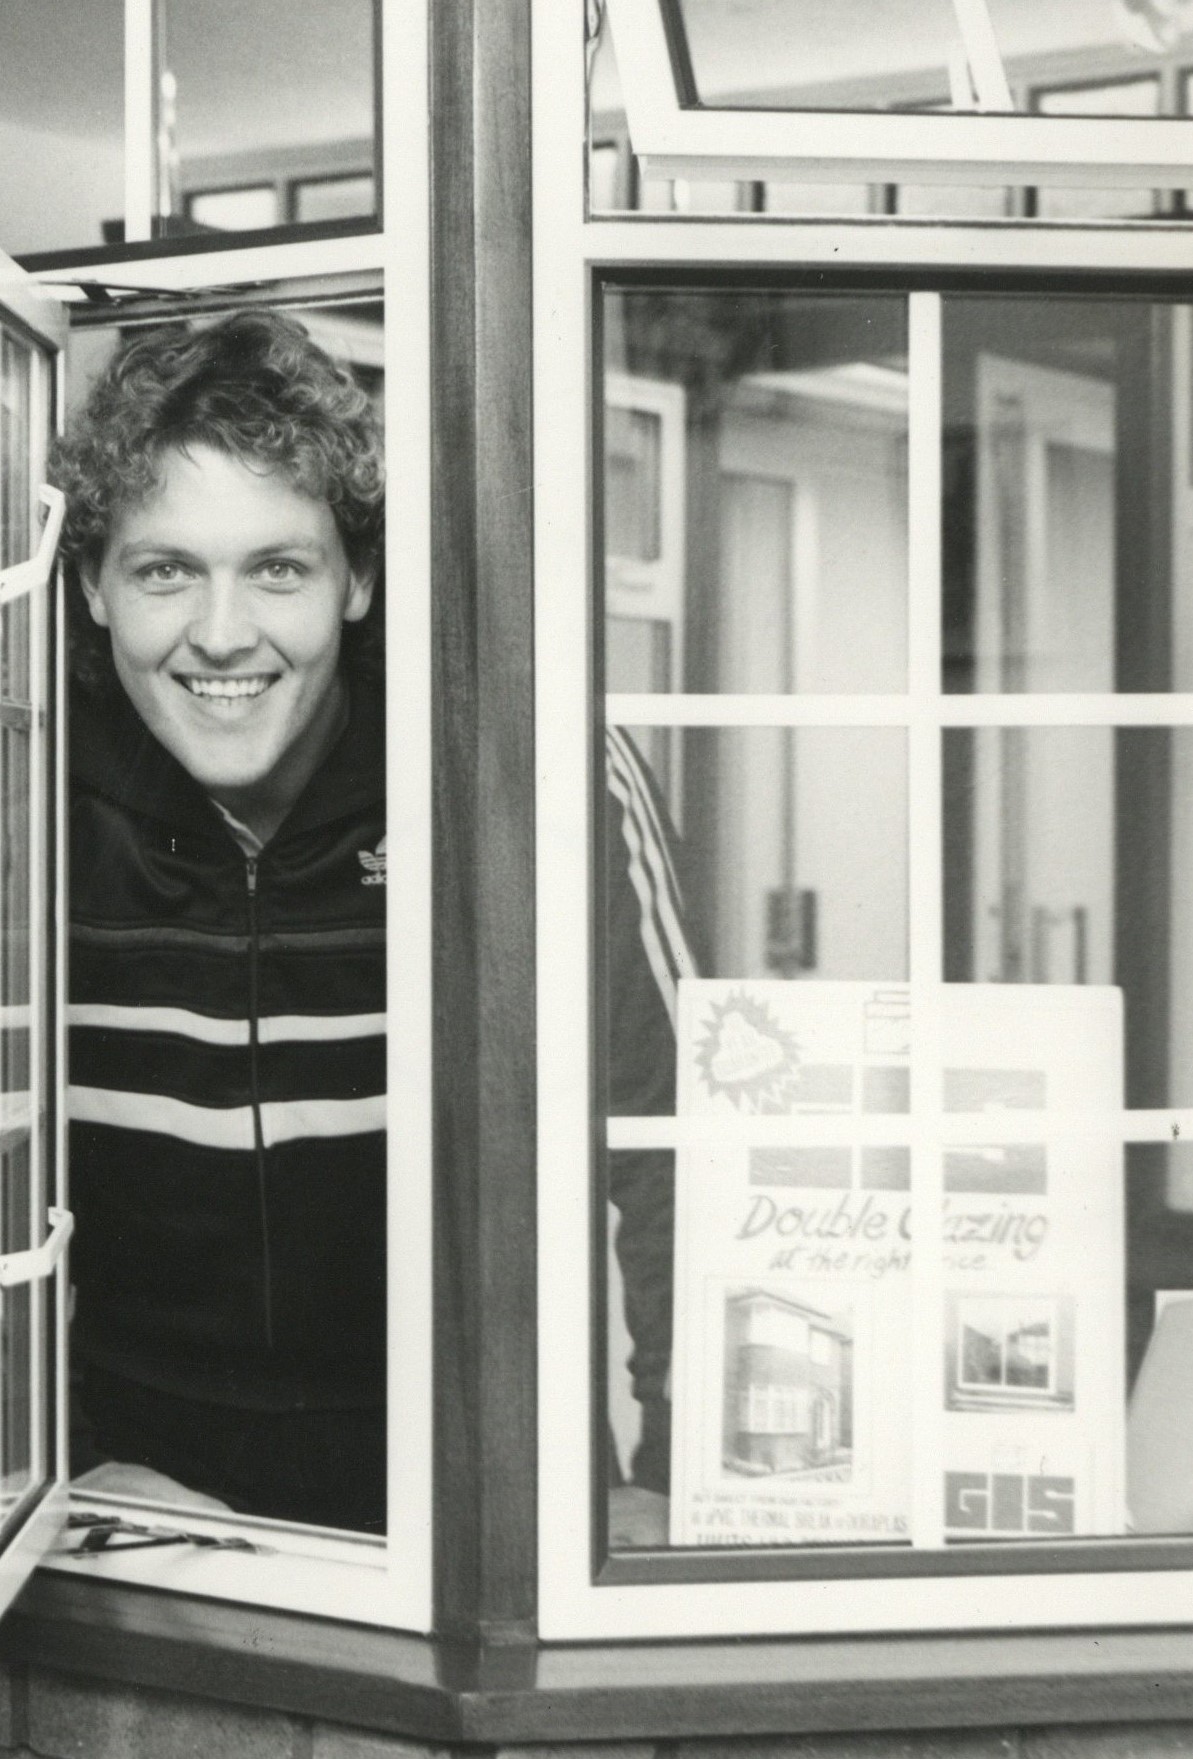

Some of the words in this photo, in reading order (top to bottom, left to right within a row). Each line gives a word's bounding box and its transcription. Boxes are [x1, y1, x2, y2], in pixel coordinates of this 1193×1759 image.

[734, 1193, 889, 1241] Double
[898, 1197, 1049, 1262] azing
[768, 1246, 805, 1270] at
[807, 1247, 849, 1271] the
[945, 1472, 1075, 1534] GIS
